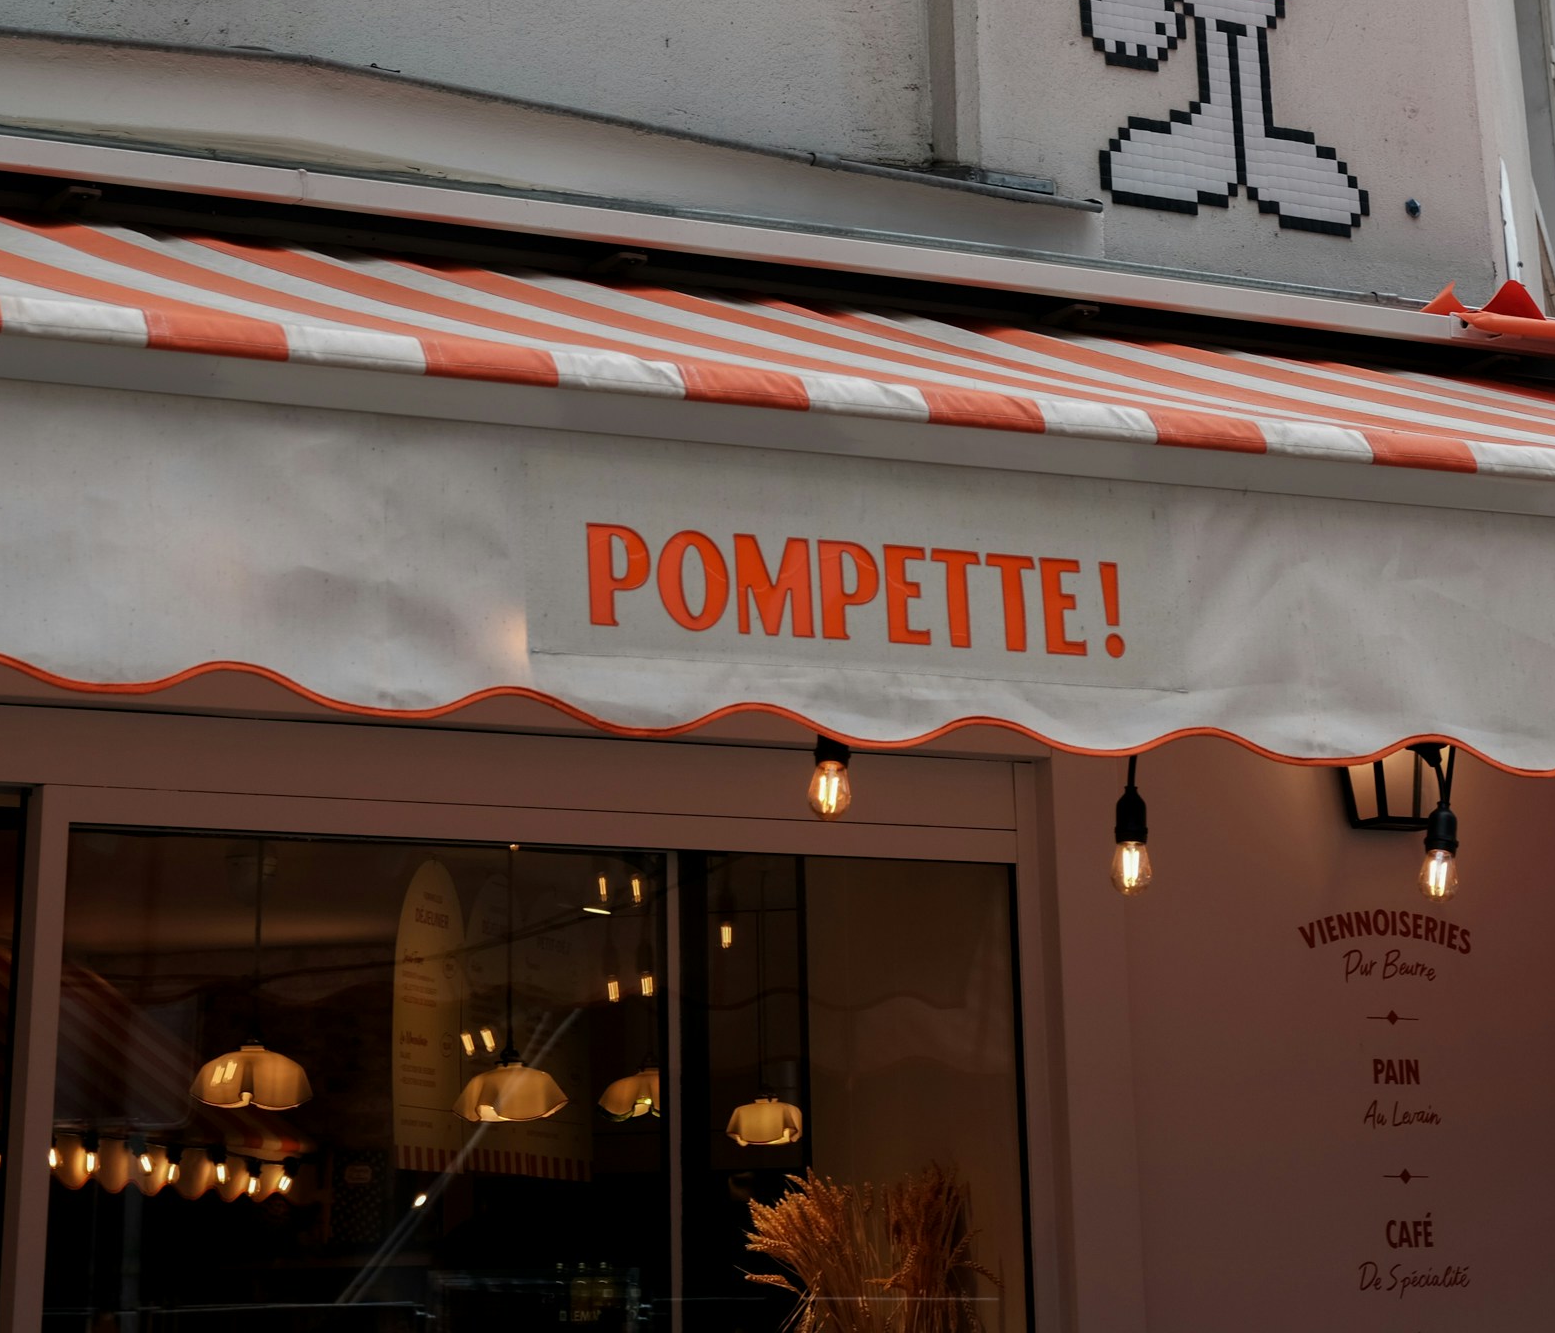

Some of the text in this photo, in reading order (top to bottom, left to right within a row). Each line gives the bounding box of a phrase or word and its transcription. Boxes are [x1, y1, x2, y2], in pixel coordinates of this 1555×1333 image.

[585, 521, 1126, 659] POMPETTE!
[1297, 908, 1472, 955] VIENNOISERIES
[1342, 948, 1437, 983] Pur Beurre
[1372, 1058, 1421, 1085] PAIN
[1363, 1099, 1442, 1130] Au Levain
[1385, 1211, 1435, 1249] CAFÉ
[1358, 1260, 1471, 1300] De Spécialité
